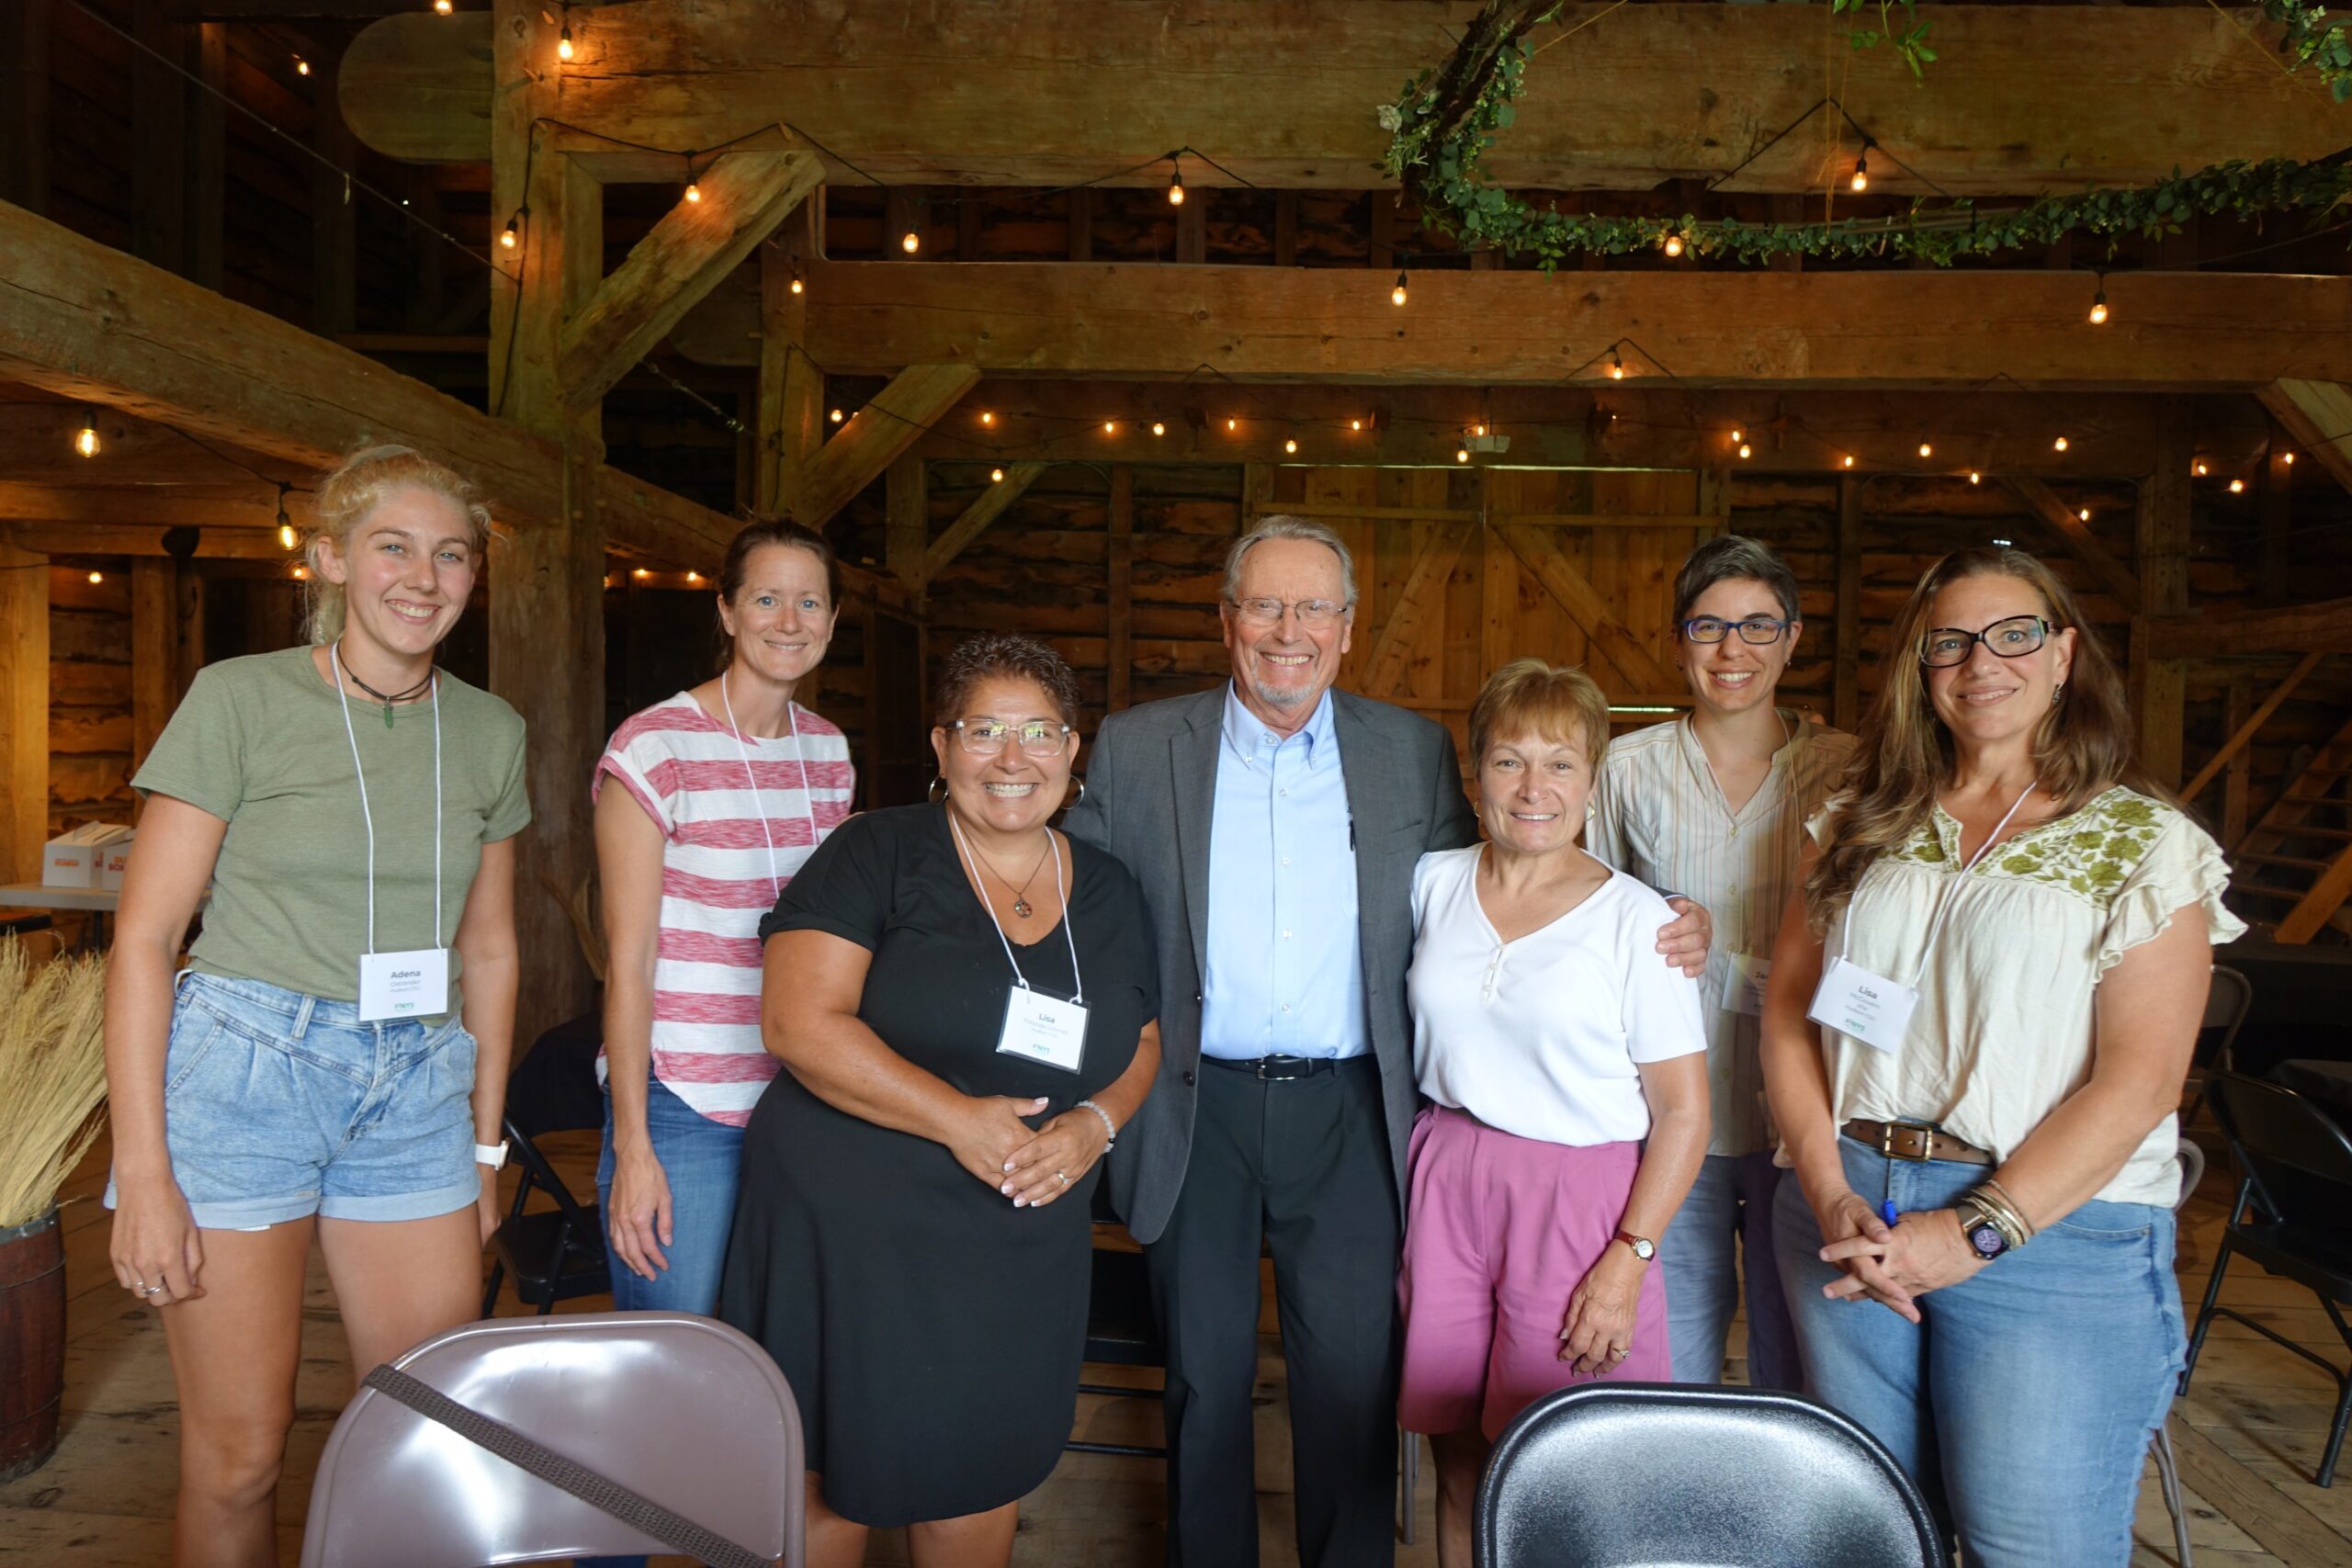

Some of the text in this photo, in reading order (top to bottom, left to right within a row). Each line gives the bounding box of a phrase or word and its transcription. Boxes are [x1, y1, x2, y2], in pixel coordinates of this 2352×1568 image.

[390, 970, 421, 978] Adena
[1859, 986, 1878, 999] Lisa
[1039, 1013, 1056, 1023] Lisa
